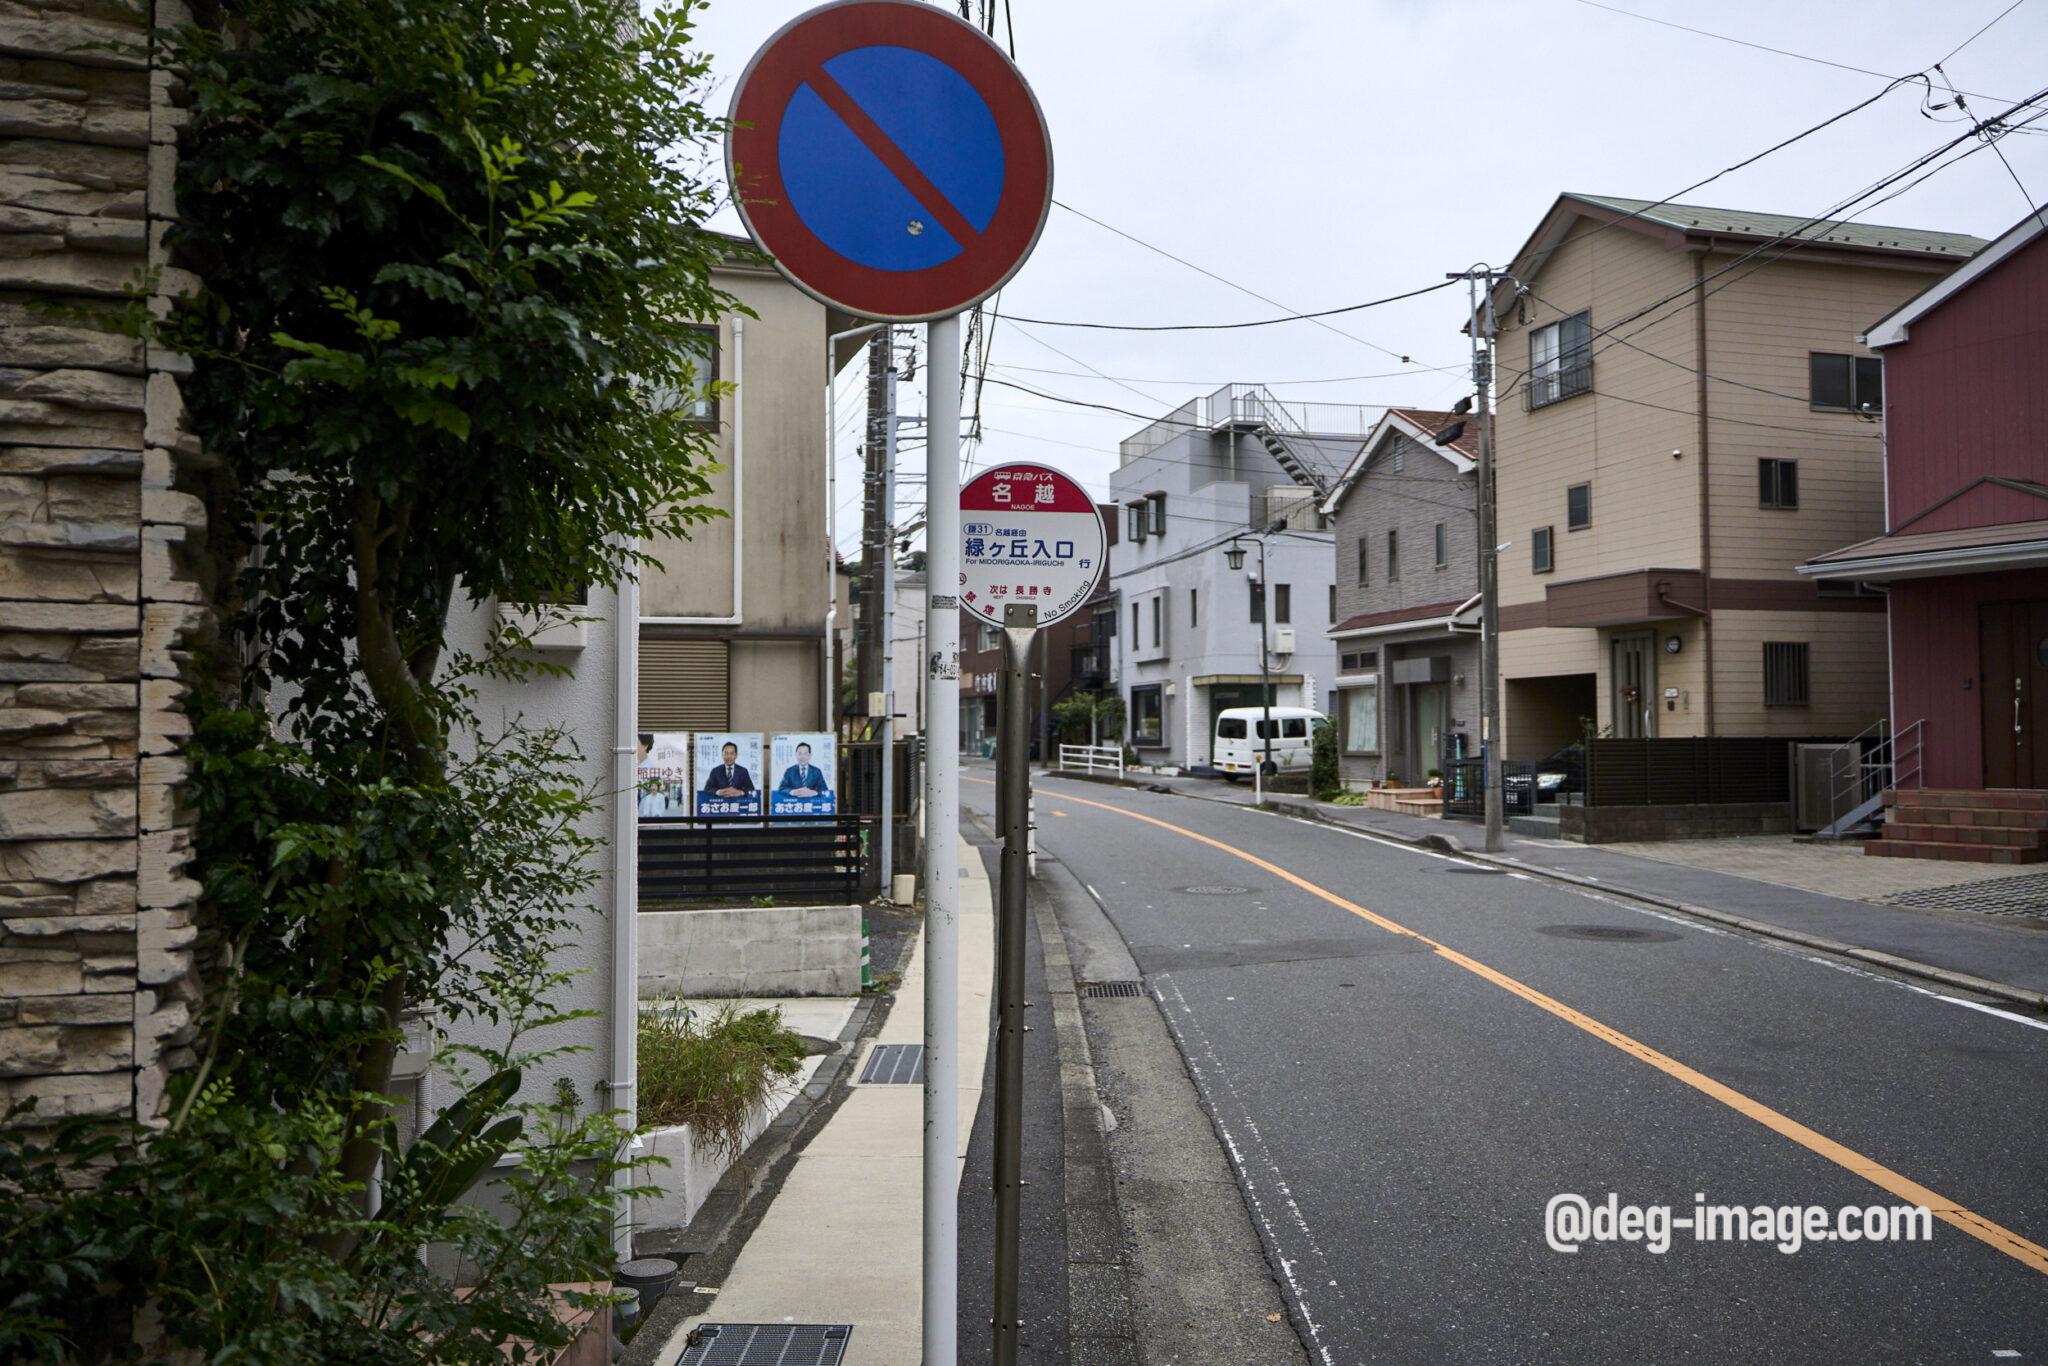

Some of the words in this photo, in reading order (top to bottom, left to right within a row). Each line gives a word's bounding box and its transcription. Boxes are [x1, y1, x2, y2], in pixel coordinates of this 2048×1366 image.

[1012, 472, 1053, 481] 京急バス
[979, 559, 1065, 567] MIDORIGAOKA-IRIGUCHI
[1078, 559, 1091, 569] 行
[989, 585, 1008, 594] 次は
[1044, 610, 1058, 620] No
[1059, 580, 1091, 612] Smoking
